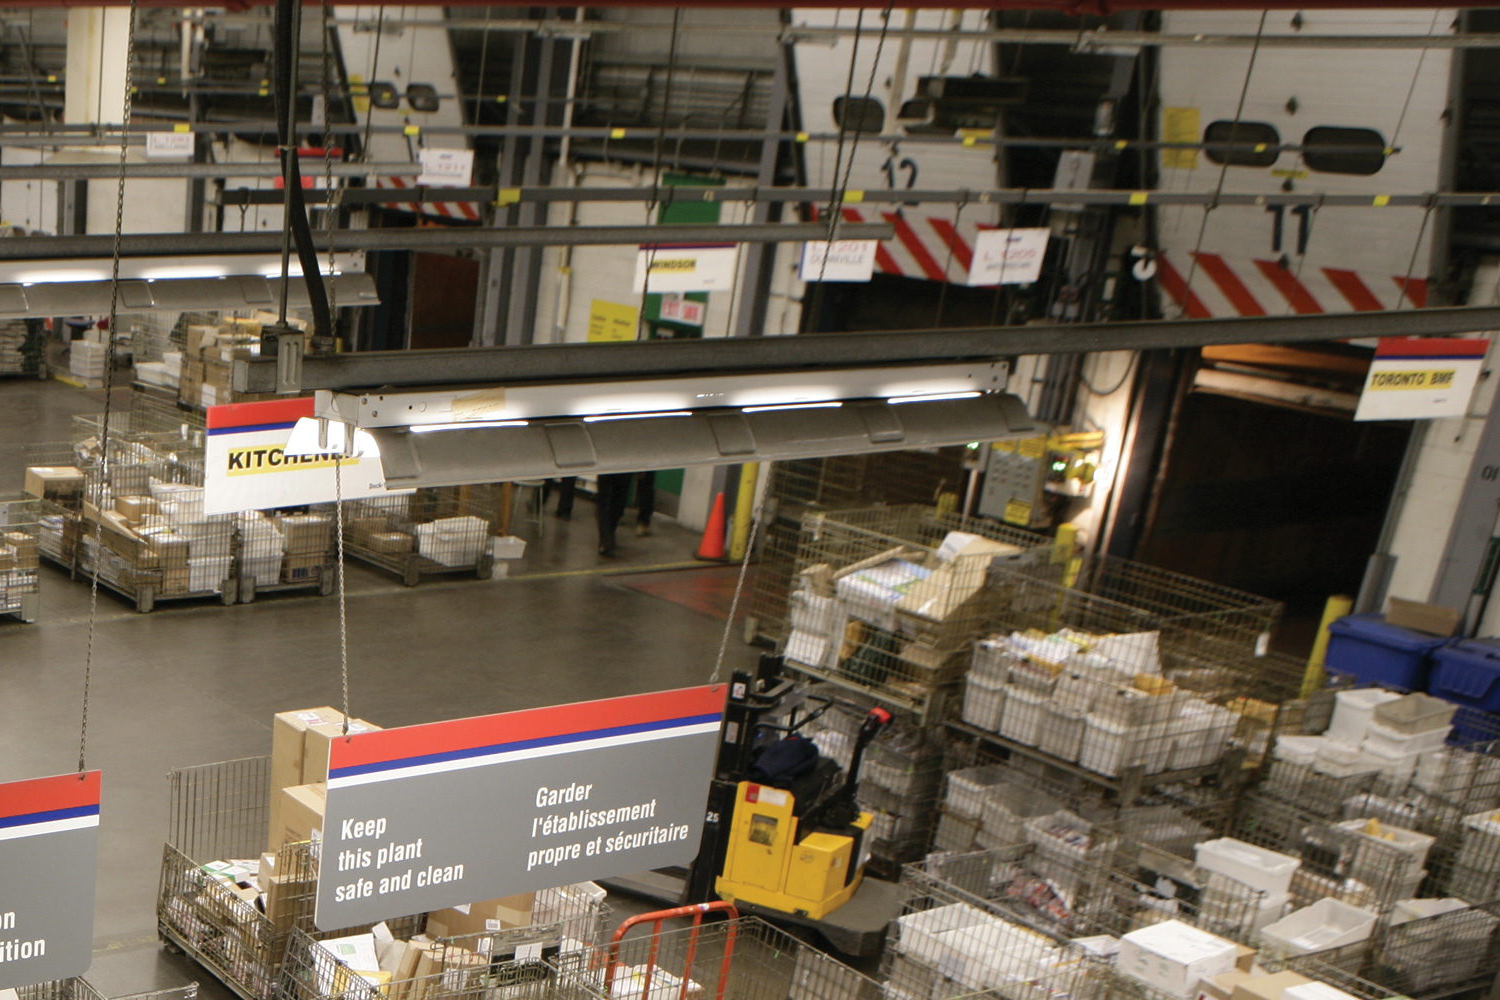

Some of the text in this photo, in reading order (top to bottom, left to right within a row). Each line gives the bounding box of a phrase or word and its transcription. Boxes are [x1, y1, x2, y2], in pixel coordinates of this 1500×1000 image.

[881, 156, 920, 207] 12
[1265, 203, 1313, 256] 11
[650, 258, 697, 270] WINDSOR
[1371, 371, 1455, 386] TORONTO BMF
[228, 447, 356, 470] KITCH
[536, 782, 593, 808] Garder
[341, 817, 387, 841] Keep
[532, 799, 656, 838] l'établissement
[706, 811, 720, 823] 25
[338, 838, 423, 872] this plant
[527, 822, 689, 873] propre et sécuritaire
[335, 863, 464, 903] safe and clean
